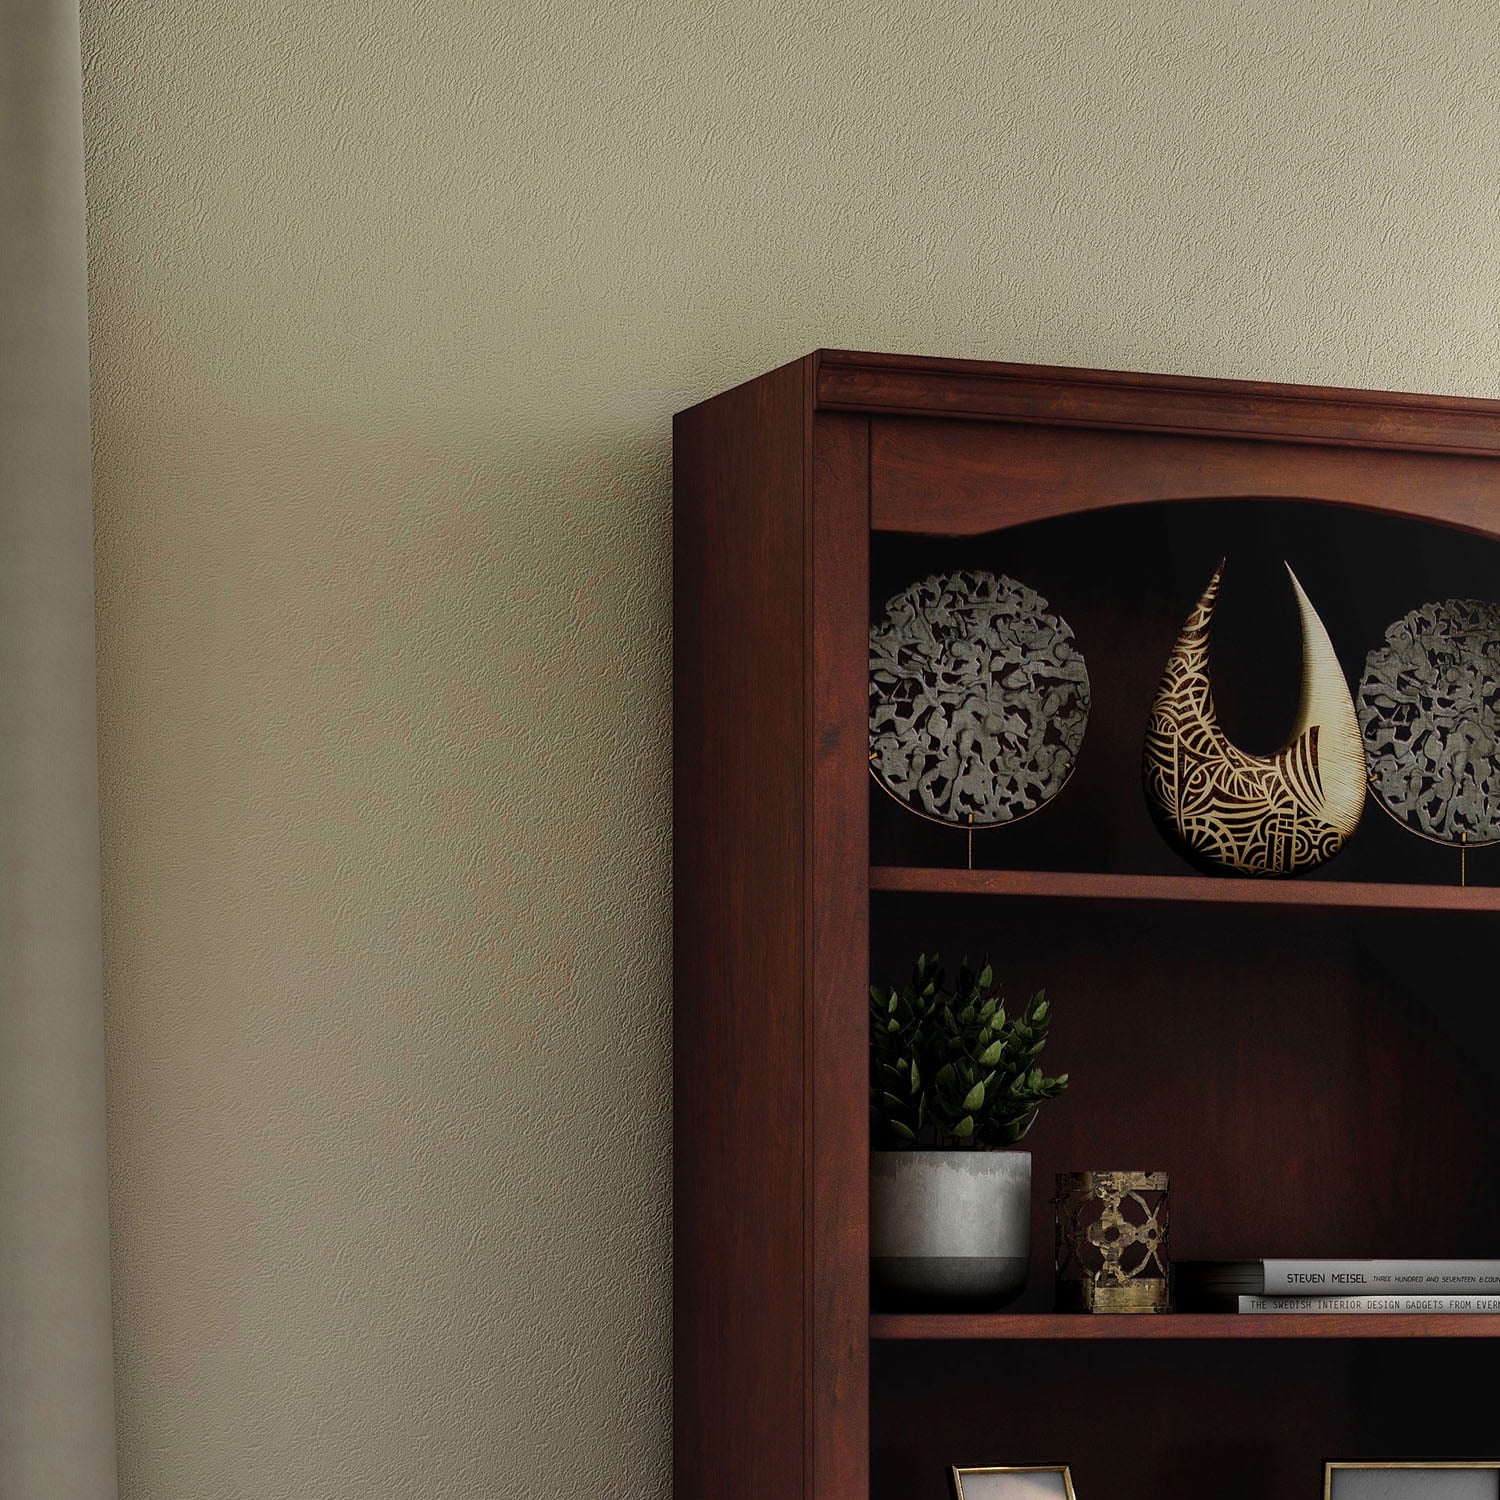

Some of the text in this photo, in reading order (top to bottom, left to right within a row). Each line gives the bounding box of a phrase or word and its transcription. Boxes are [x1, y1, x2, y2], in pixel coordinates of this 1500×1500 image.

[1286, 1273, 1326, 1284] STEVEN
[1331, 1273, 1367, 1284] MEISEL
[1372, 1275, 1393, 1283] THREE
[1394, 1275, 1424, 1283] HUNDRED
[1425, 1275, 1439, 1283] AND
[1441, 1275, 1476, 1283] SEVENTEEN
[1251, 1300, 1267, 1309] THE
[1272, 1300, 1312, 1309] SWEDISH
[1317, 1300, 1362, 1309] INTERIOR
[1367, 1300, 1400, 1309] DESIGN
[1405, 1300, 1444, 1309] GADGETS
[1449, 1300, 1472, 1309] FROM
